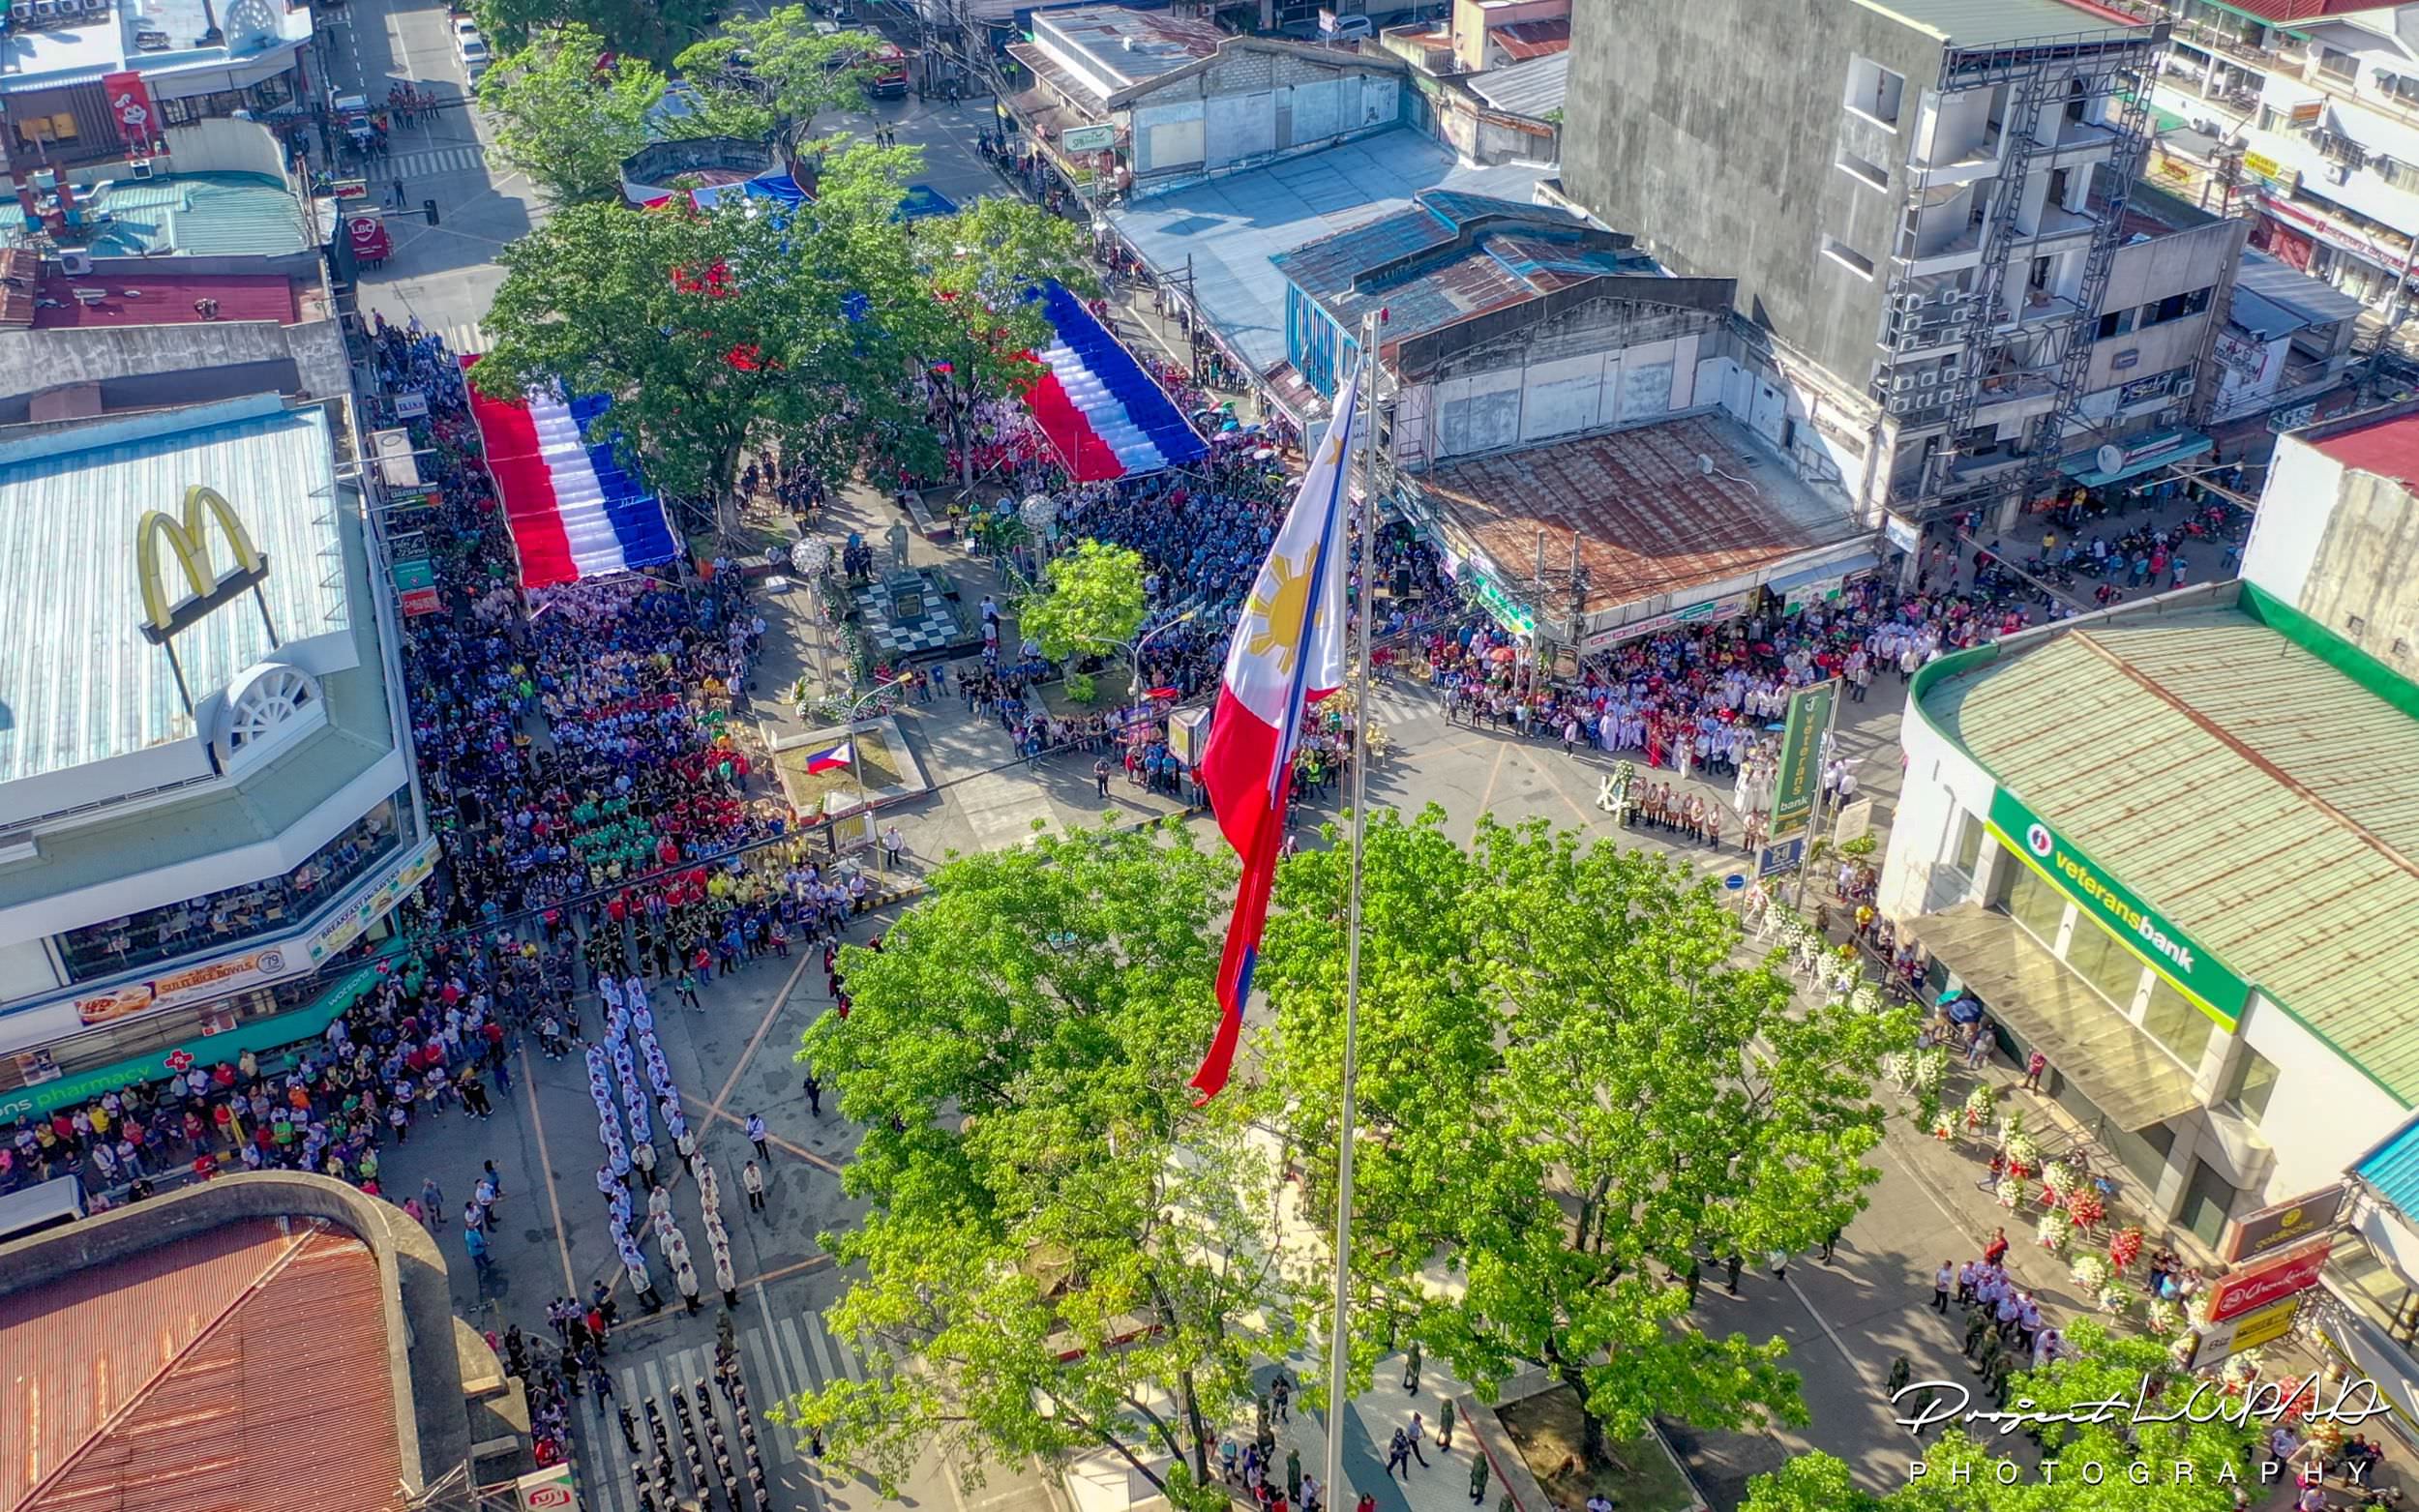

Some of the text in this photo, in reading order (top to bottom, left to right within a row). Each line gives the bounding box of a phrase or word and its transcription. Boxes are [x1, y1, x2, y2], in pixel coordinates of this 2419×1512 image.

[351, 222, 373, 234] LBC
[1792, 715, 1815, 795] veterans
[1780, 796, 1808, 812] bank
[217, 961, 253, 979] BOWLS
[328, 968, 370, 1007] watsons
[37, 1066, 151, 1108] pharmacy
